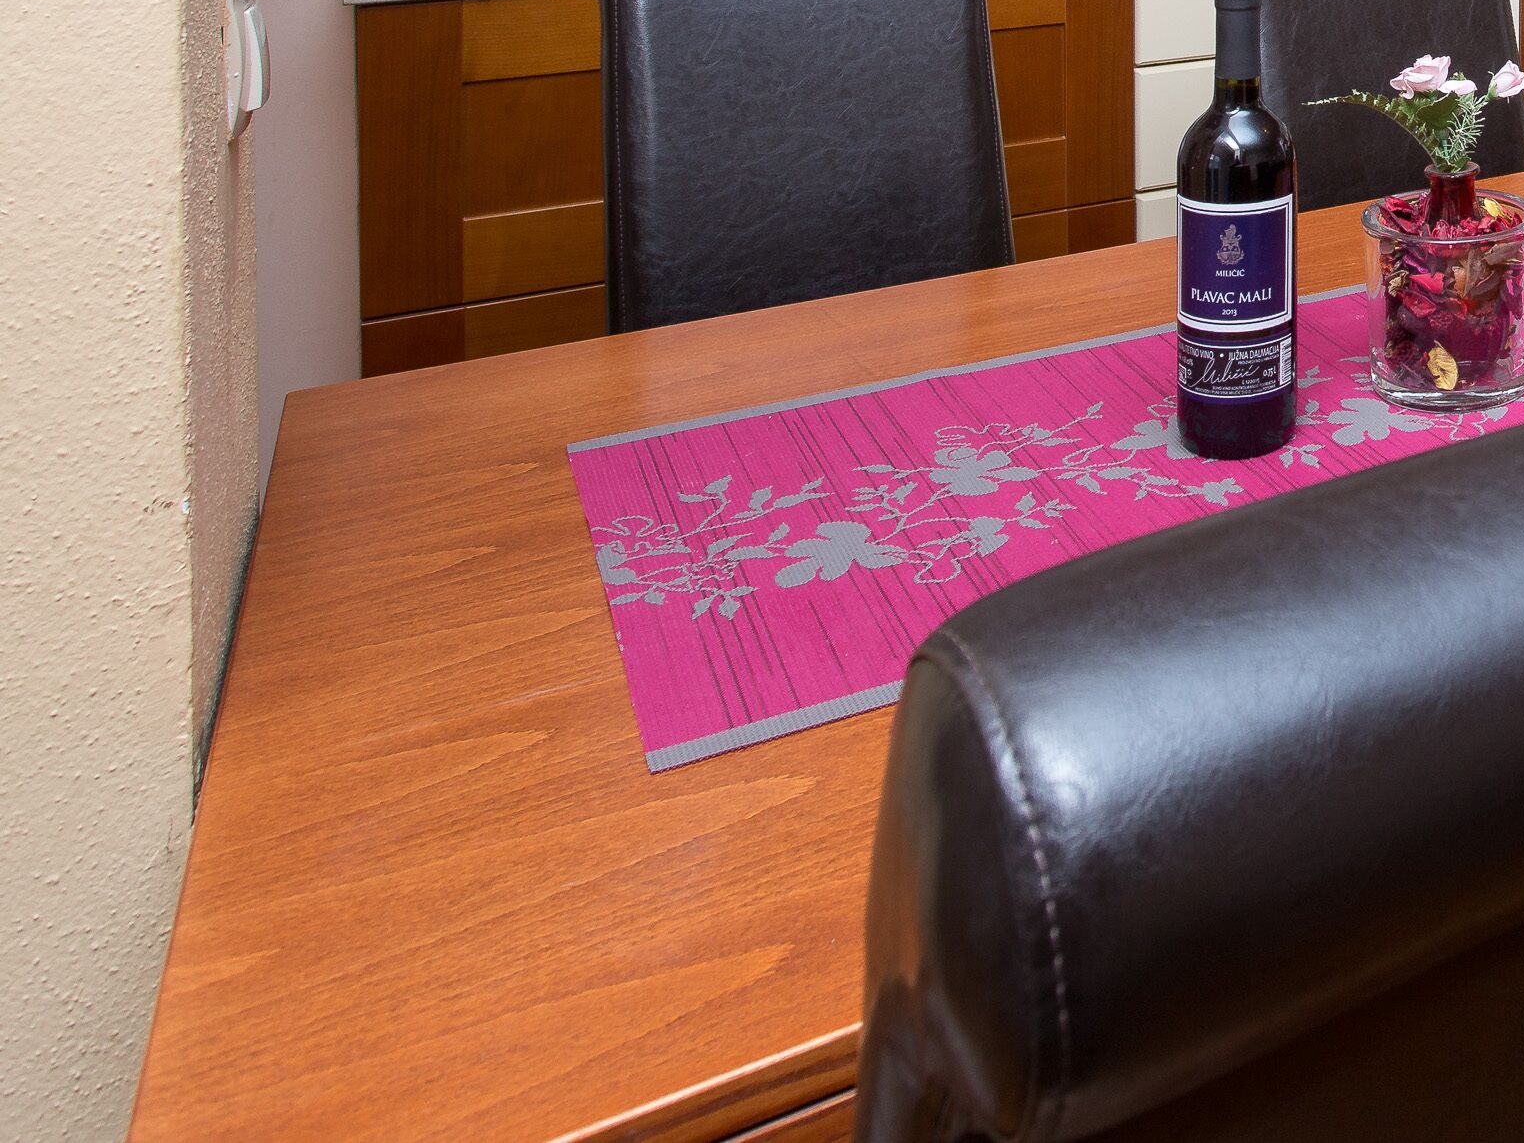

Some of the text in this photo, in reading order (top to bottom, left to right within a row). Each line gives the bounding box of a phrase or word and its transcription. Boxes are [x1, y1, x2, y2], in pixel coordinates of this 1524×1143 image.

[1191, 287, 1272, 304] PLAVAC MALI
[1221, 309, 1238, 317] 2013
